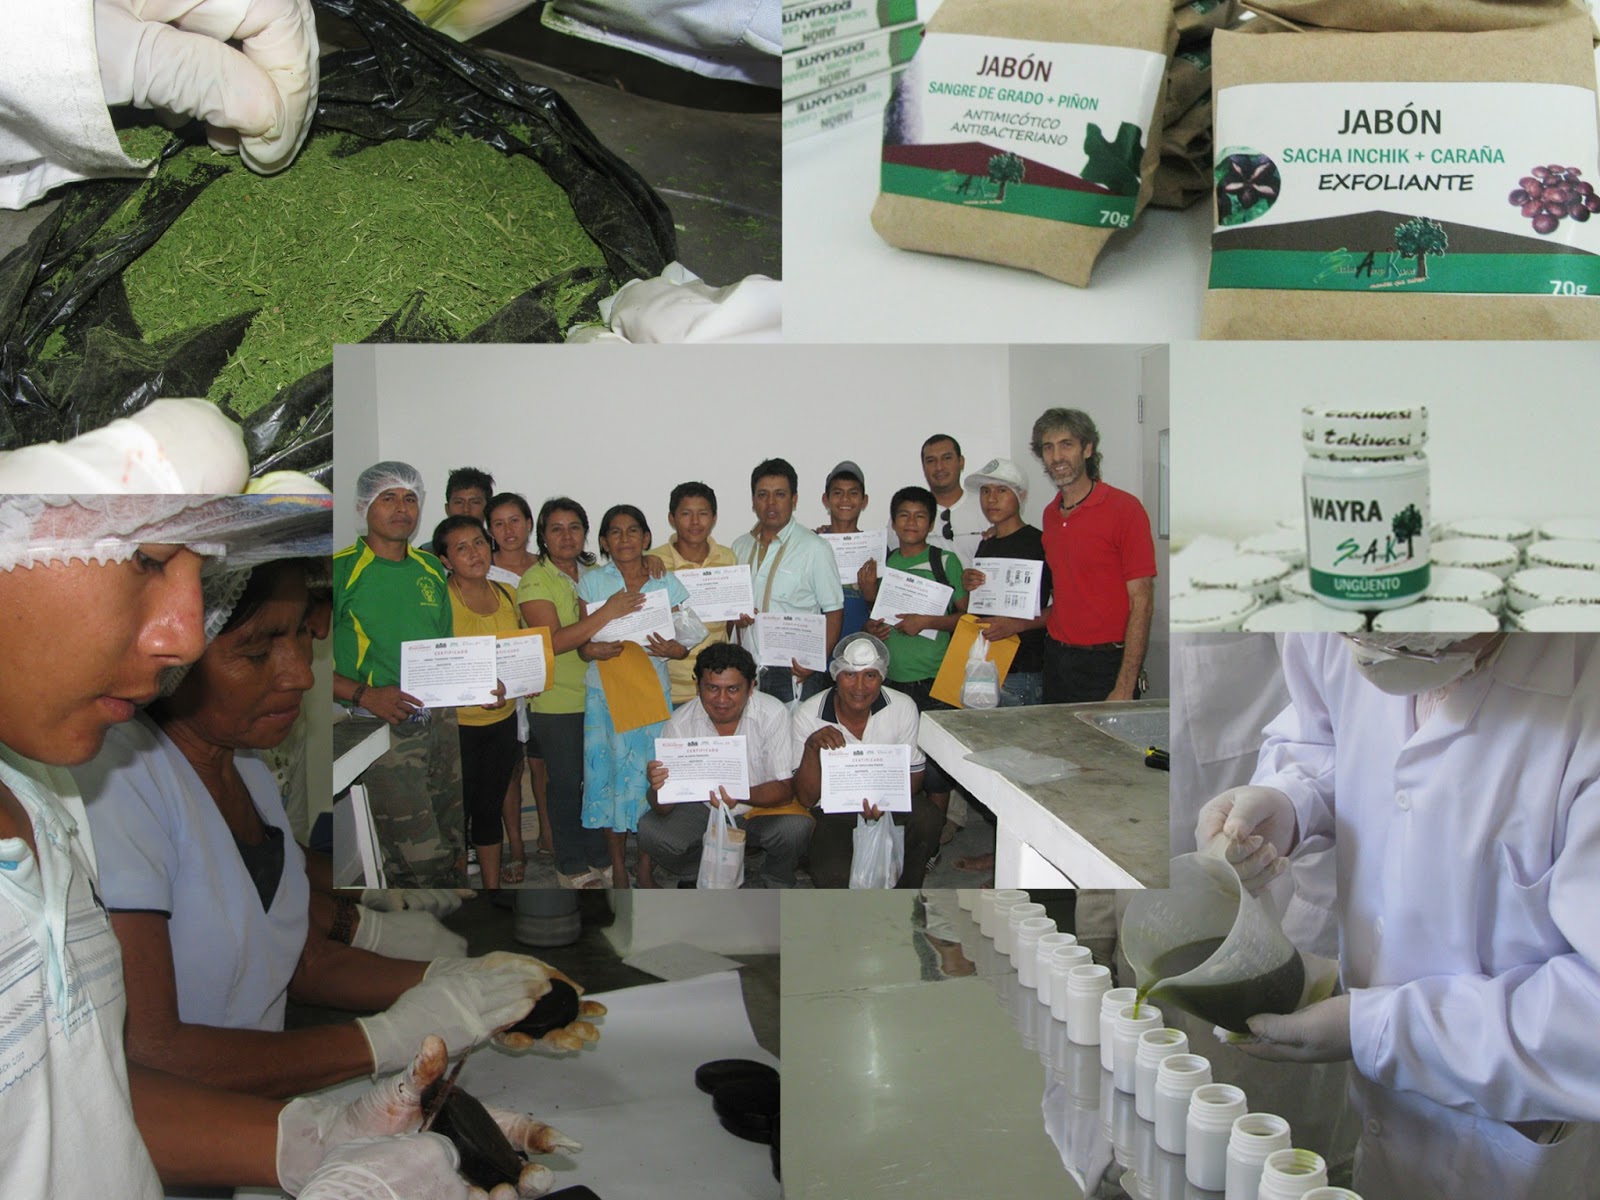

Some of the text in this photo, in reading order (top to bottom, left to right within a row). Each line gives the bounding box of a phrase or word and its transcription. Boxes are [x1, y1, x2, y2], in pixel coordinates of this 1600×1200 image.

[977, 53, 1053, 83] JABÓN
[928, 81, 1100, 111] SANGRE DE GRADO + PIÑON
[963, 109, 1061, 130] ANTIMICÓTICO
[1337, 102, 1442, 135] JABÓN
[950, 122, 1068, 146] ANTIBACTERIANO
[1282, 145, 1505, 164] SACHA INCHIK + CARAÑA
[1318, 173, 1474, 191] EXFOLIANTE
[1100, 210, 1130, 228] 70g
[1550, 280, 1588, 297] 70g
[1324, 429, 1412, 446] takiwasi
[1310, 497, 1383, 522] WAYRA
[1333, 577, 1400, 592] UNGÜENTO
